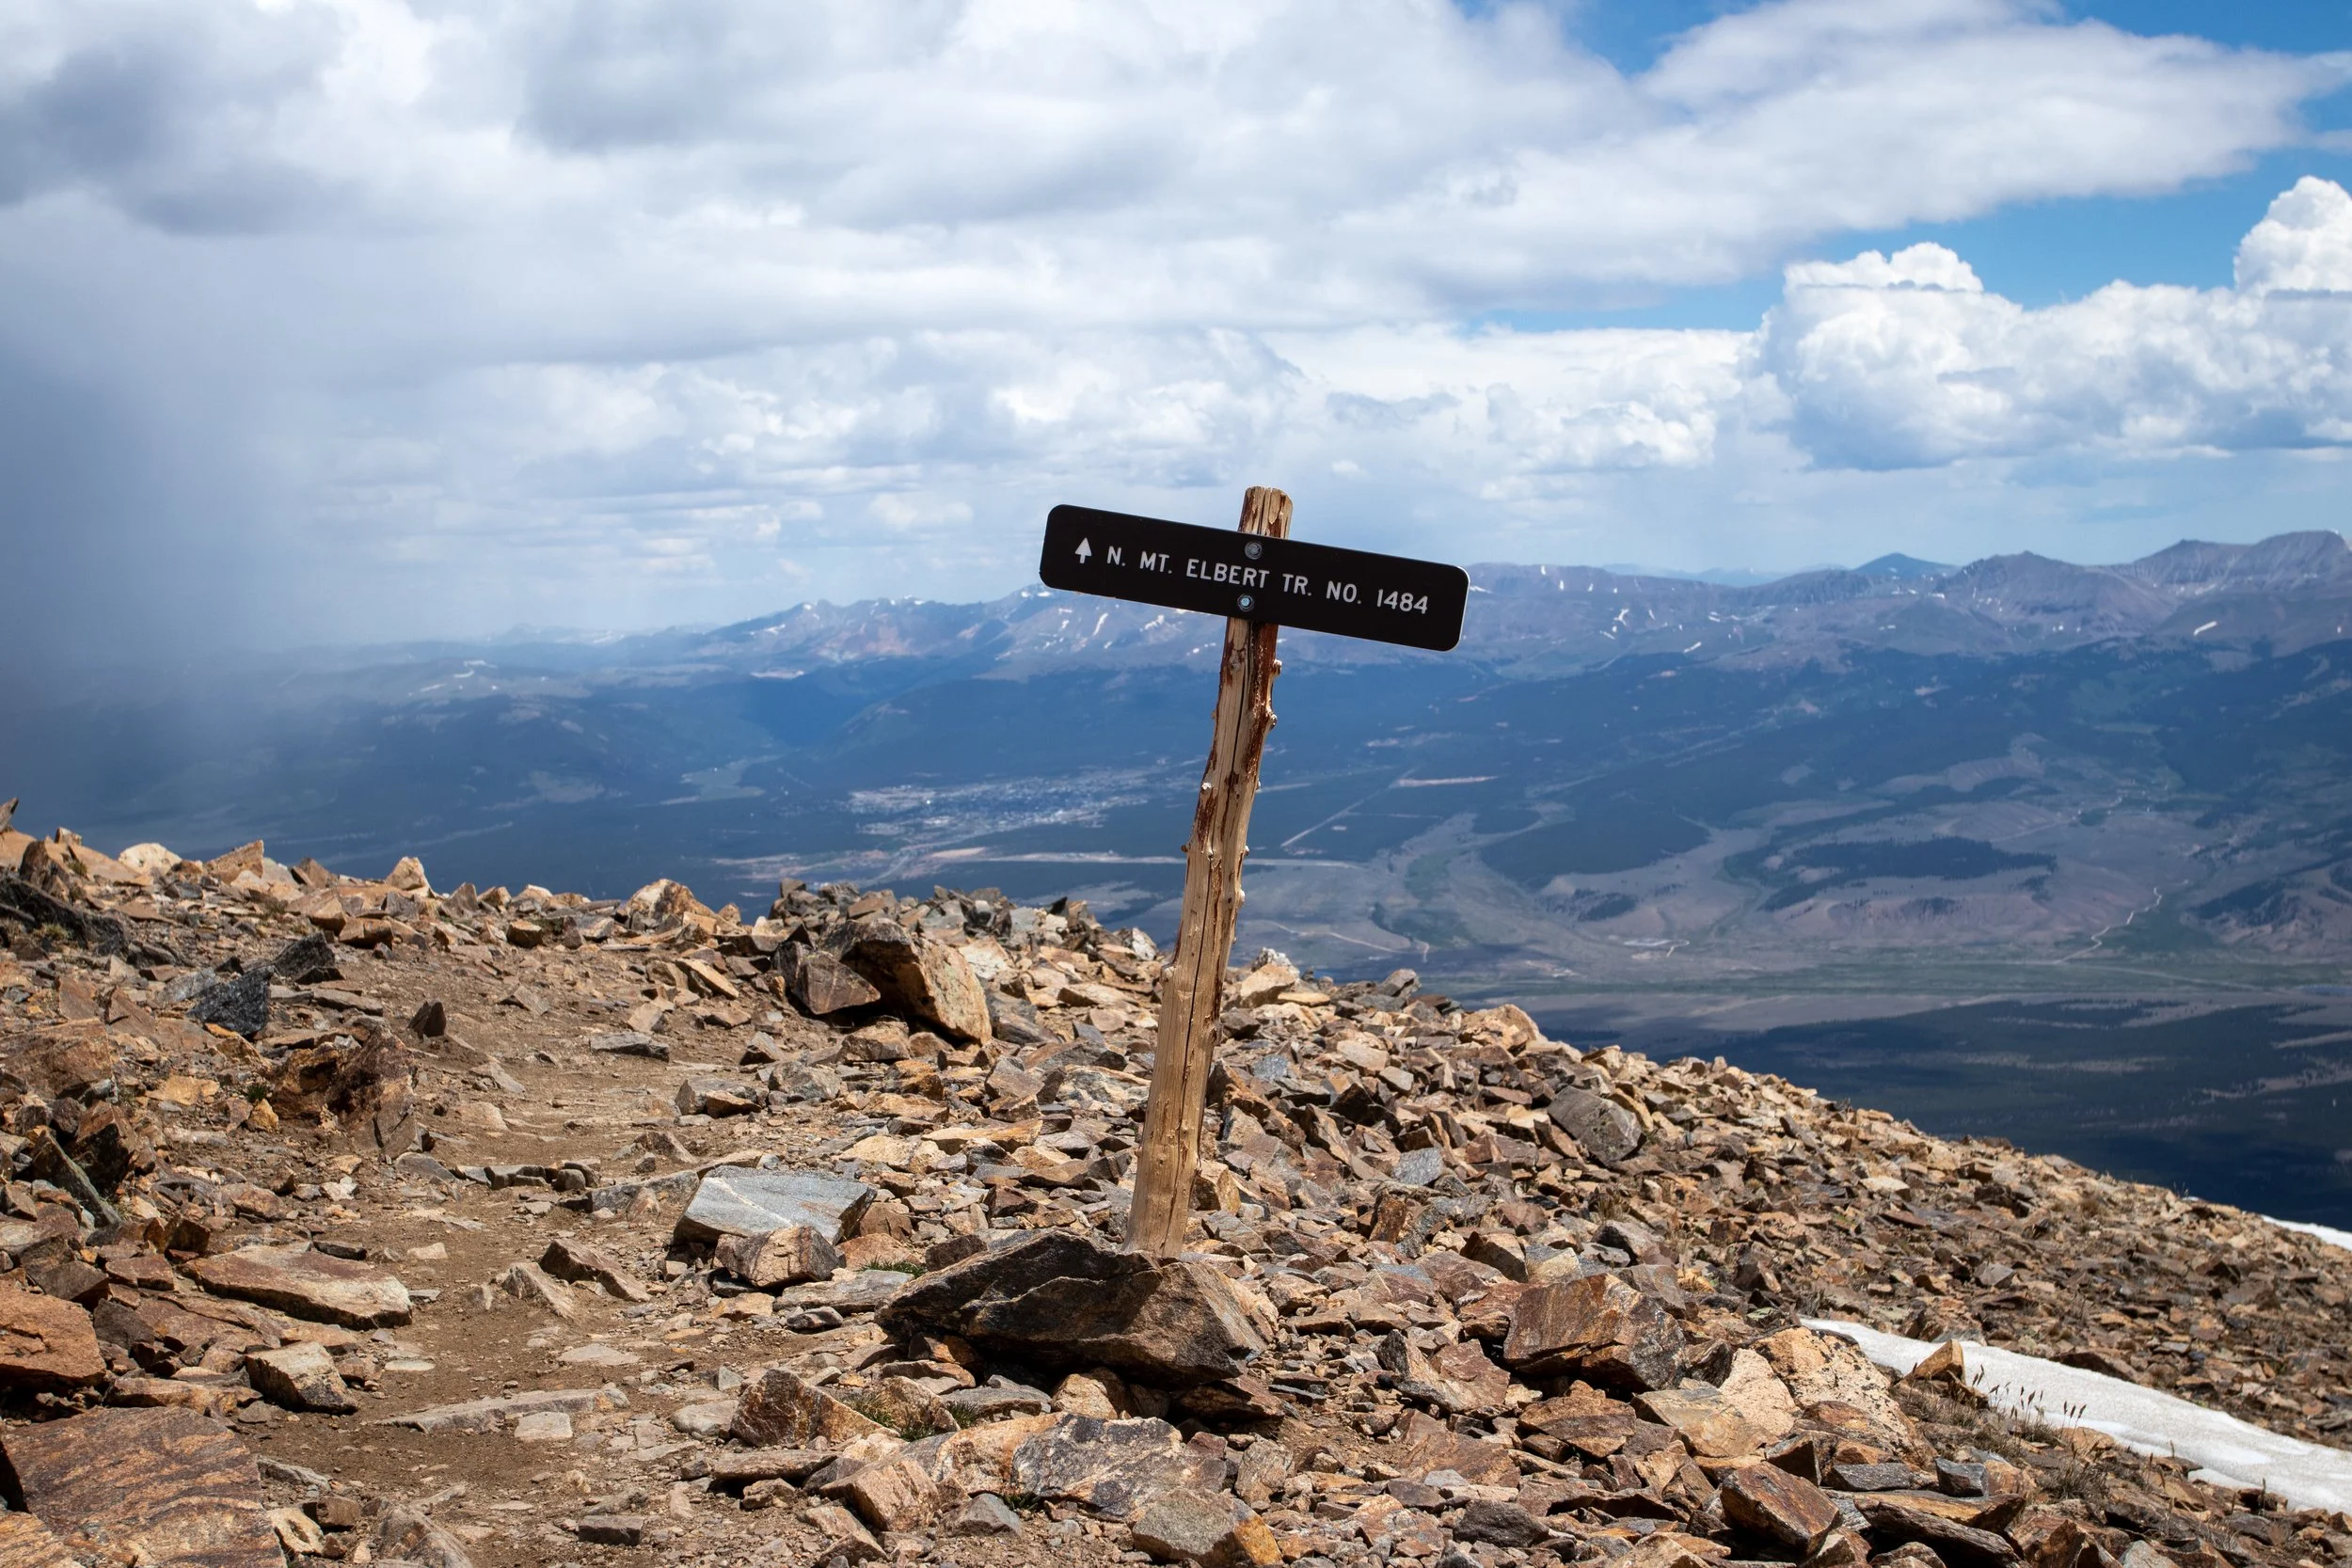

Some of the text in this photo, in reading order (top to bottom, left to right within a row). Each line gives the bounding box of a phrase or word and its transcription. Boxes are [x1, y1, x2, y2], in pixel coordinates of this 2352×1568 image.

[1106, 546, 1428, 614] N. MT. ELBERT TR. NO. 1484
